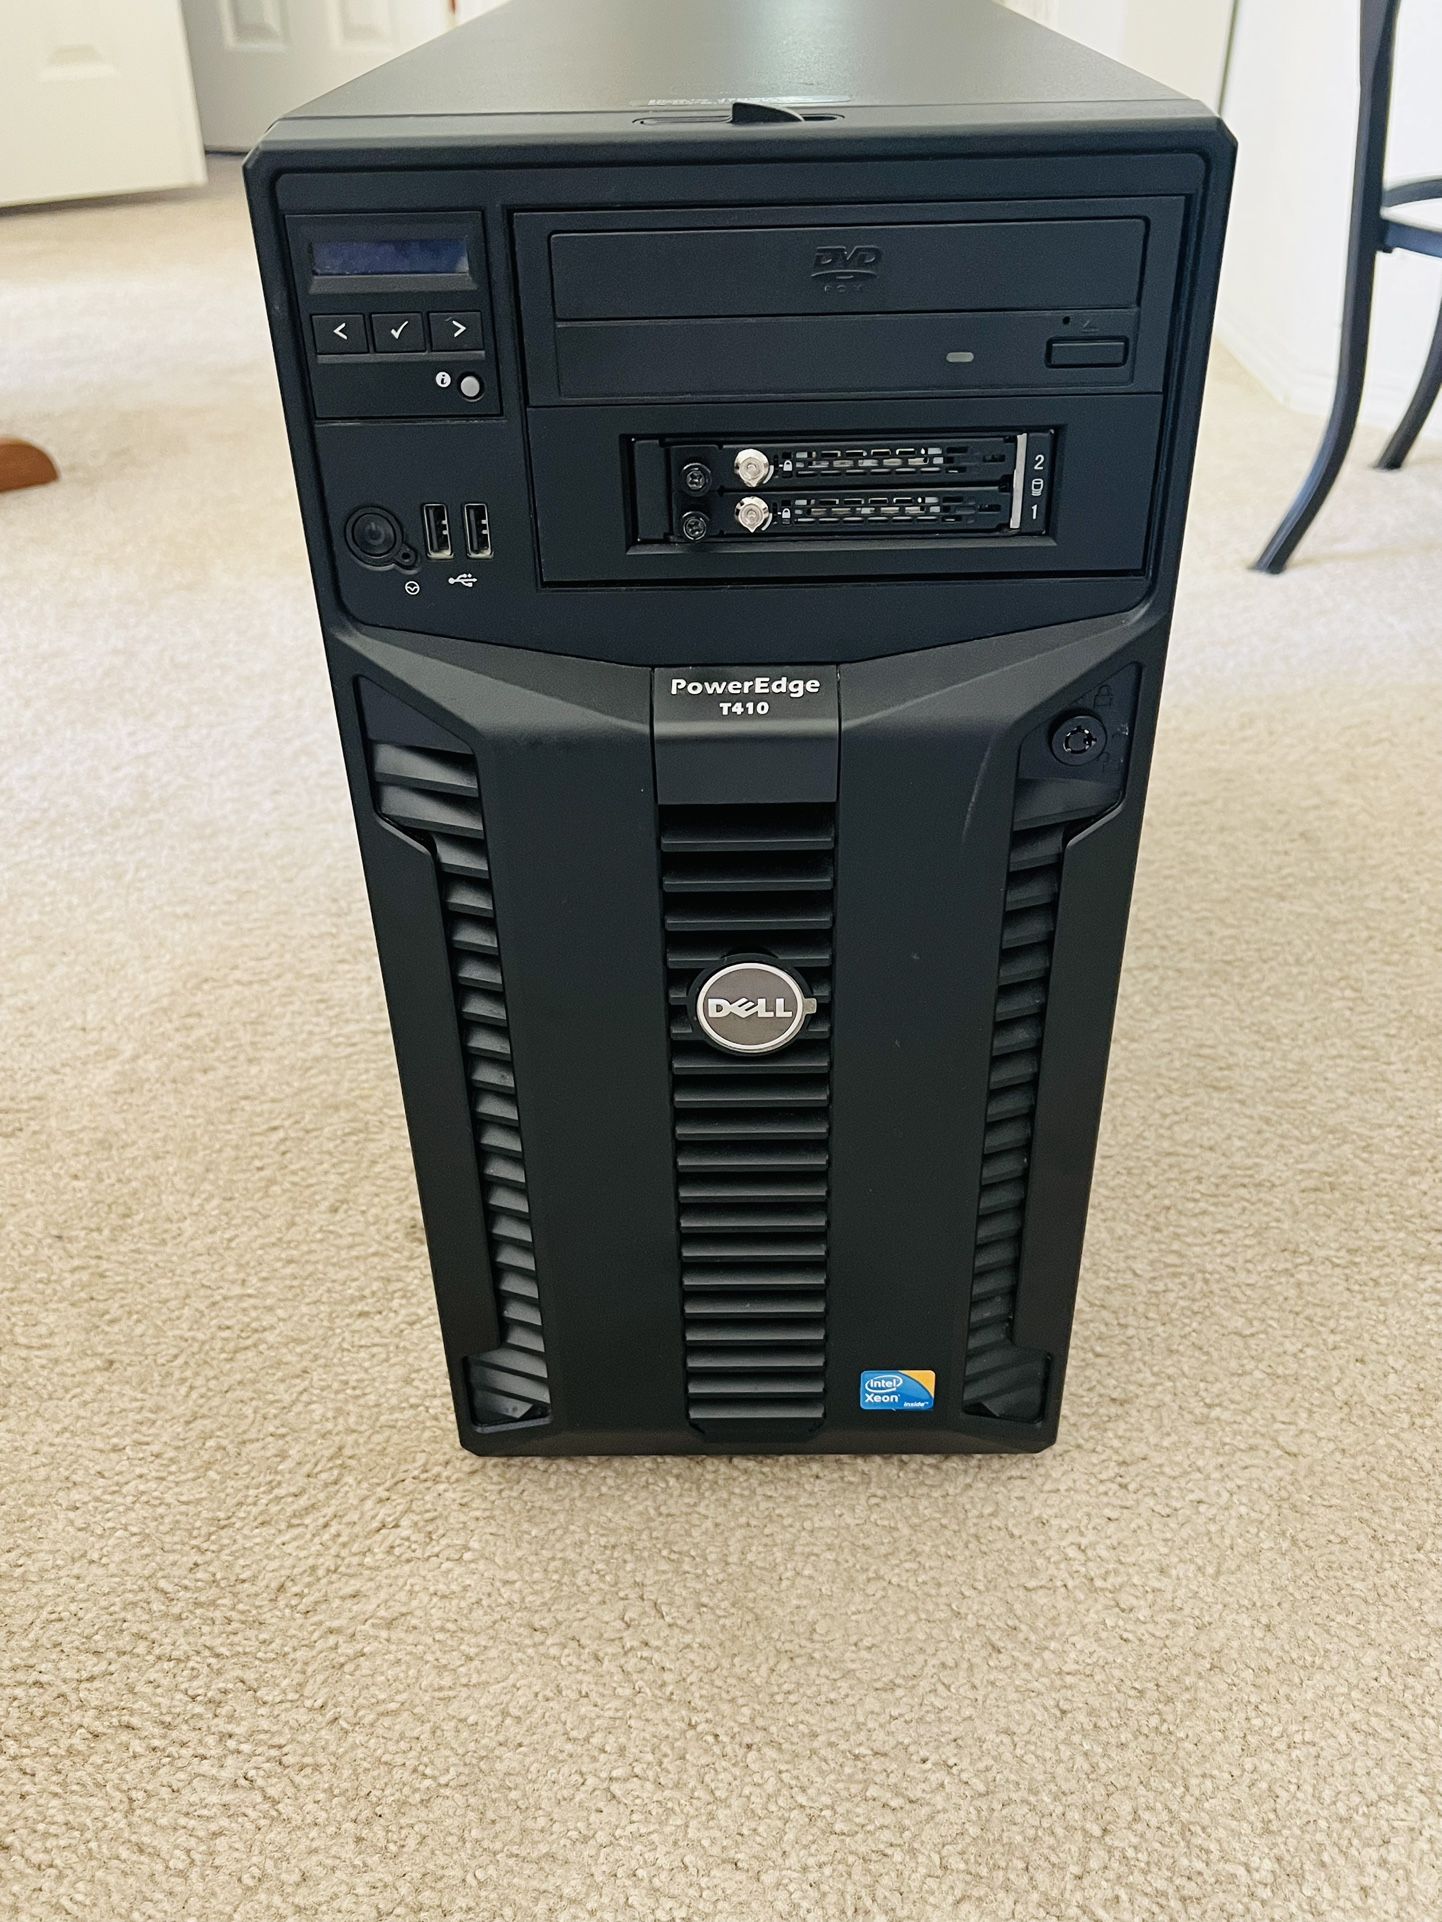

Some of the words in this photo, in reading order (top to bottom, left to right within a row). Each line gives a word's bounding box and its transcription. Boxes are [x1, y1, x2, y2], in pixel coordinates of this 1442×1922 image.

[814, 245, 881, 269] DVD
[1033, 454, 1045, 470] 2
[1031, 504, 1038, 520] 1
[670, 676, 821, 698] PowerEdge
[719, 701, 770, 716] T410
[707, 997, 793, 1019] DELL
[864, 1393, 899, 1403] Xeon
